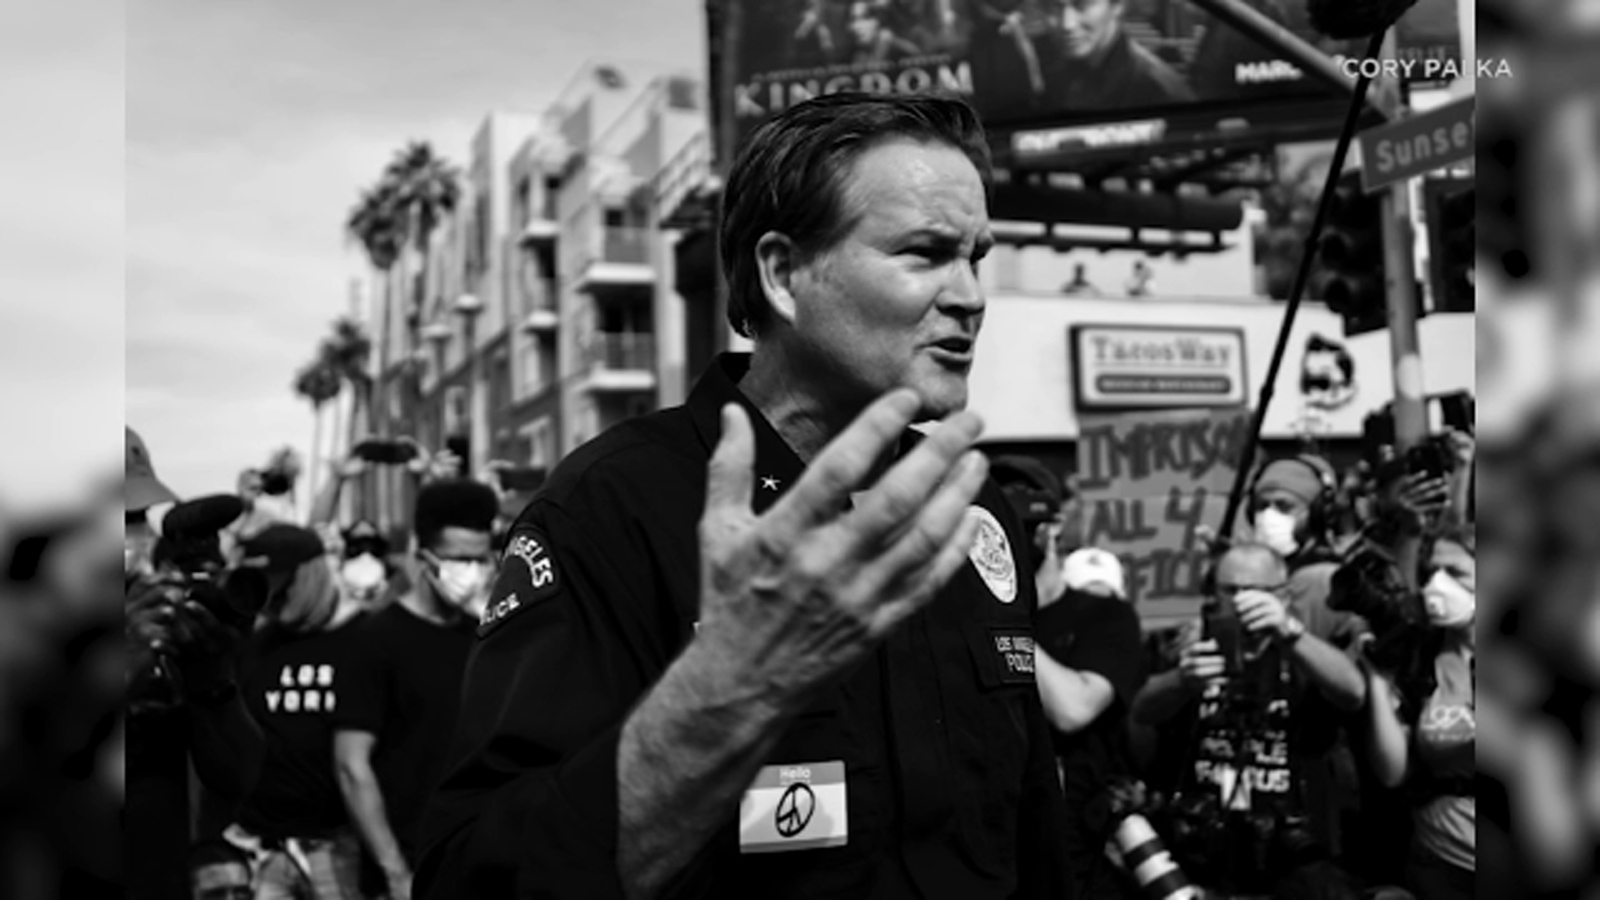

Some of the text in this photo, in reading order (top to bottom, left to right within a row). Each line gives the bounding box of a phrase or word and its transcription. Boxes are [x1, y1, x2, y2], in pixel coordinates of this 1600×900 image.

[734, 61, 975, 117] KINGDOM
[1086, 486, 1208, 553] ALL 4
[1118, 547, 1210, 605] FICE
